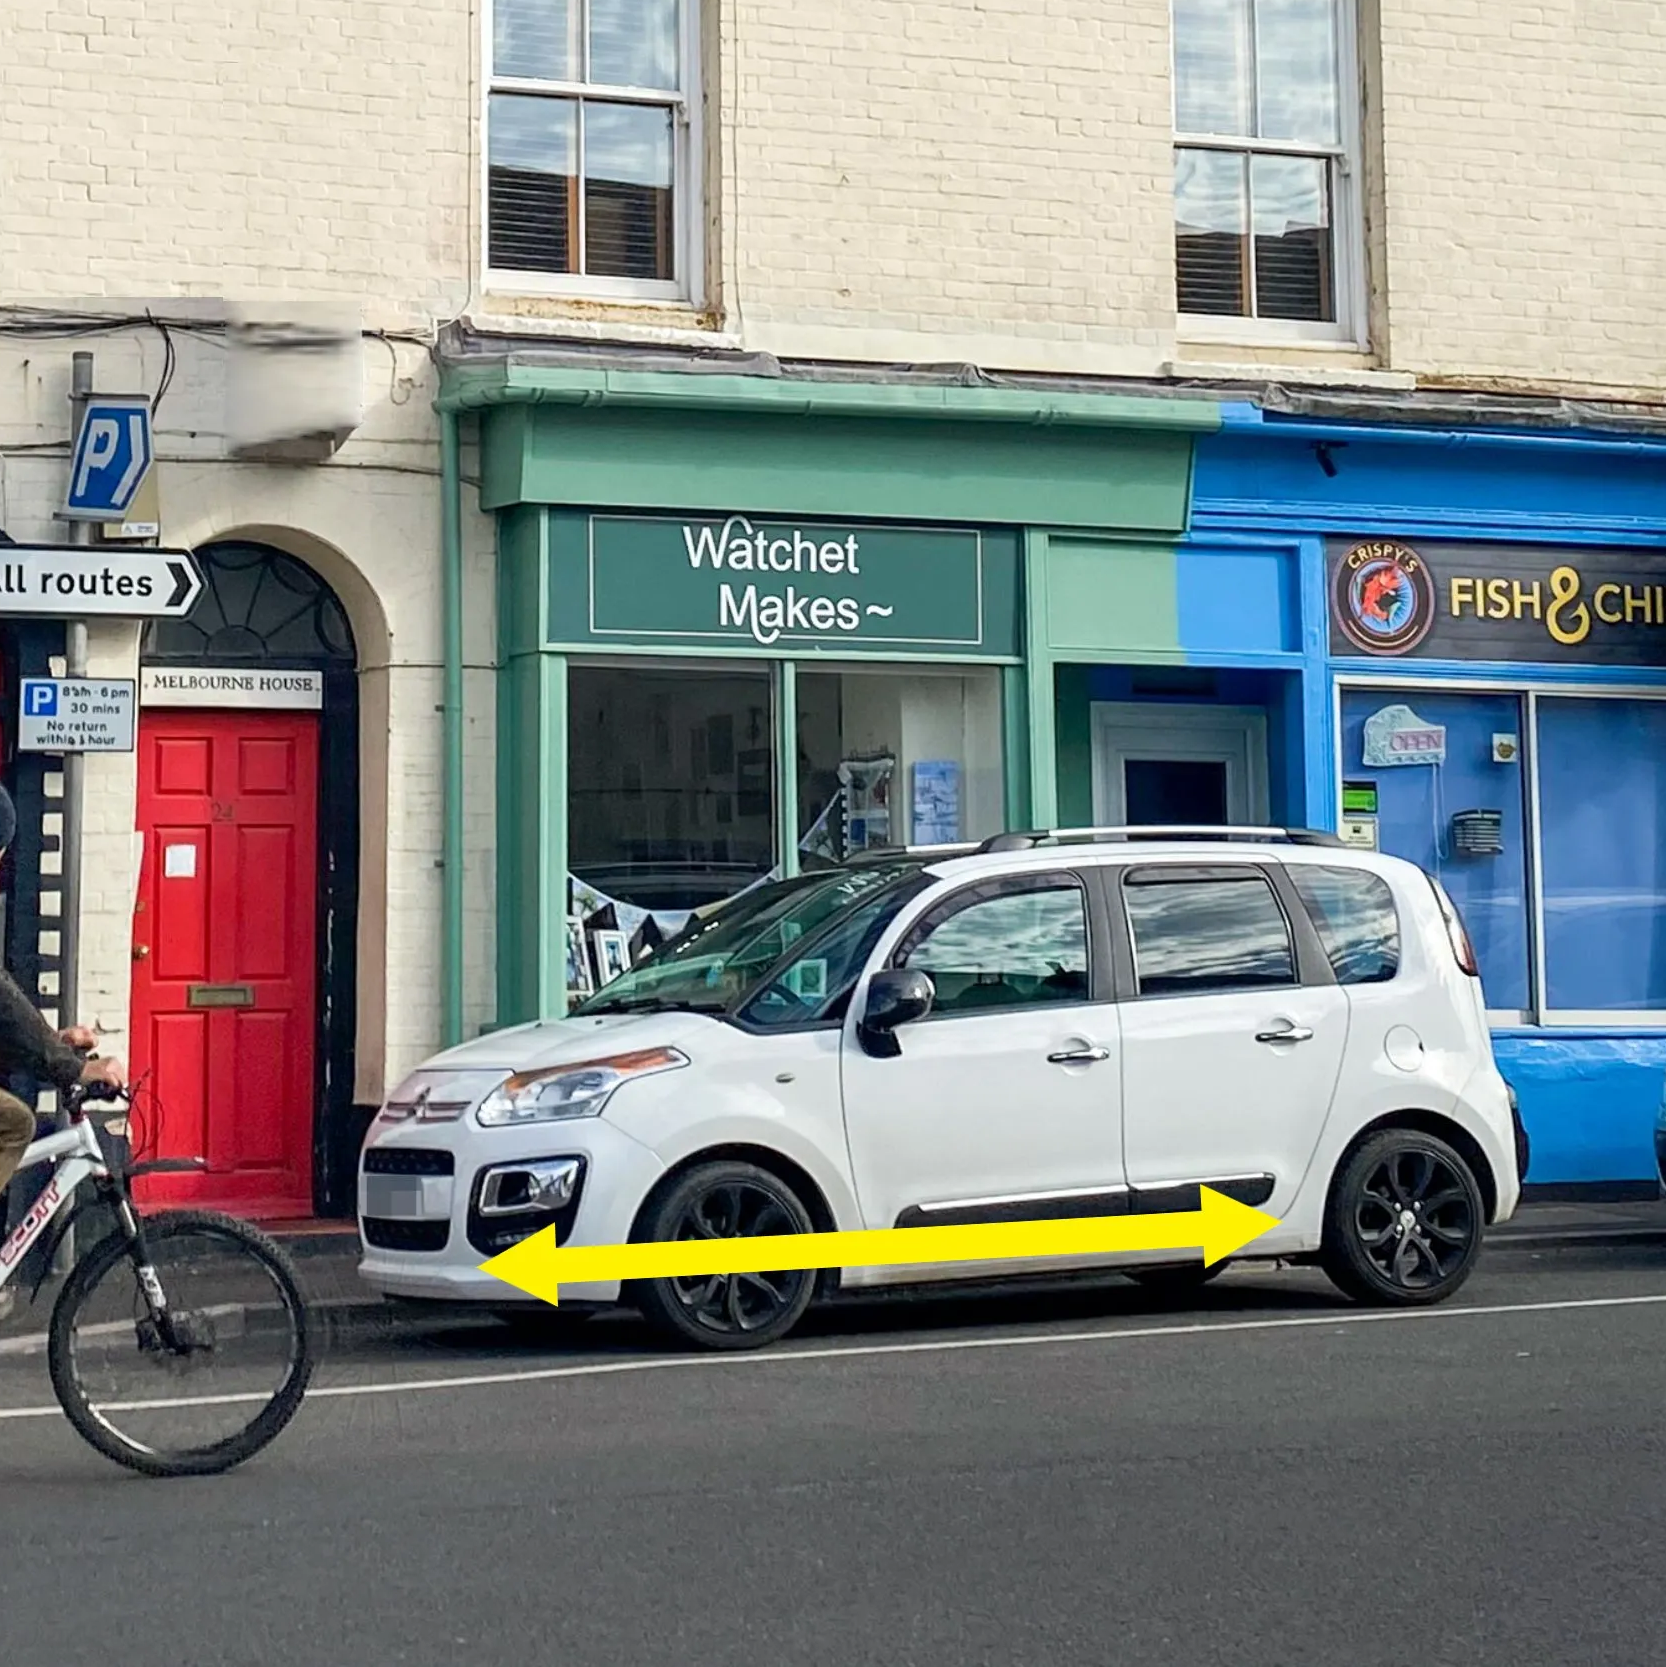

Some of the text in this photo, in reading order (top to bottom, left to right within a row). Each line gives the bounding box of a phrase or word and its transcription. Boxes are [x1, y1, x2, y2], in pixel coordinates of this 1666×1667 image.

[683, 515, 860, 575] Watchet
[1347, 542, 1418, 573] CRISPY'S
[39, 568, 153, 597] routes
[719, 584, 859, 644] Makes
[1450, 577, 1542, 620] FISH
[1545, 565, 1591, 645] &
[153, 674, 313, 692] MELBOURNE HOUSE
[71, 702, 120, 715] 30 mins
[47, 720, 107, 732] No return
[88, 734, 116, 745] hour
[1391, 734, 1442, 751] OPEN
[211, 802, 233, 822] 24
